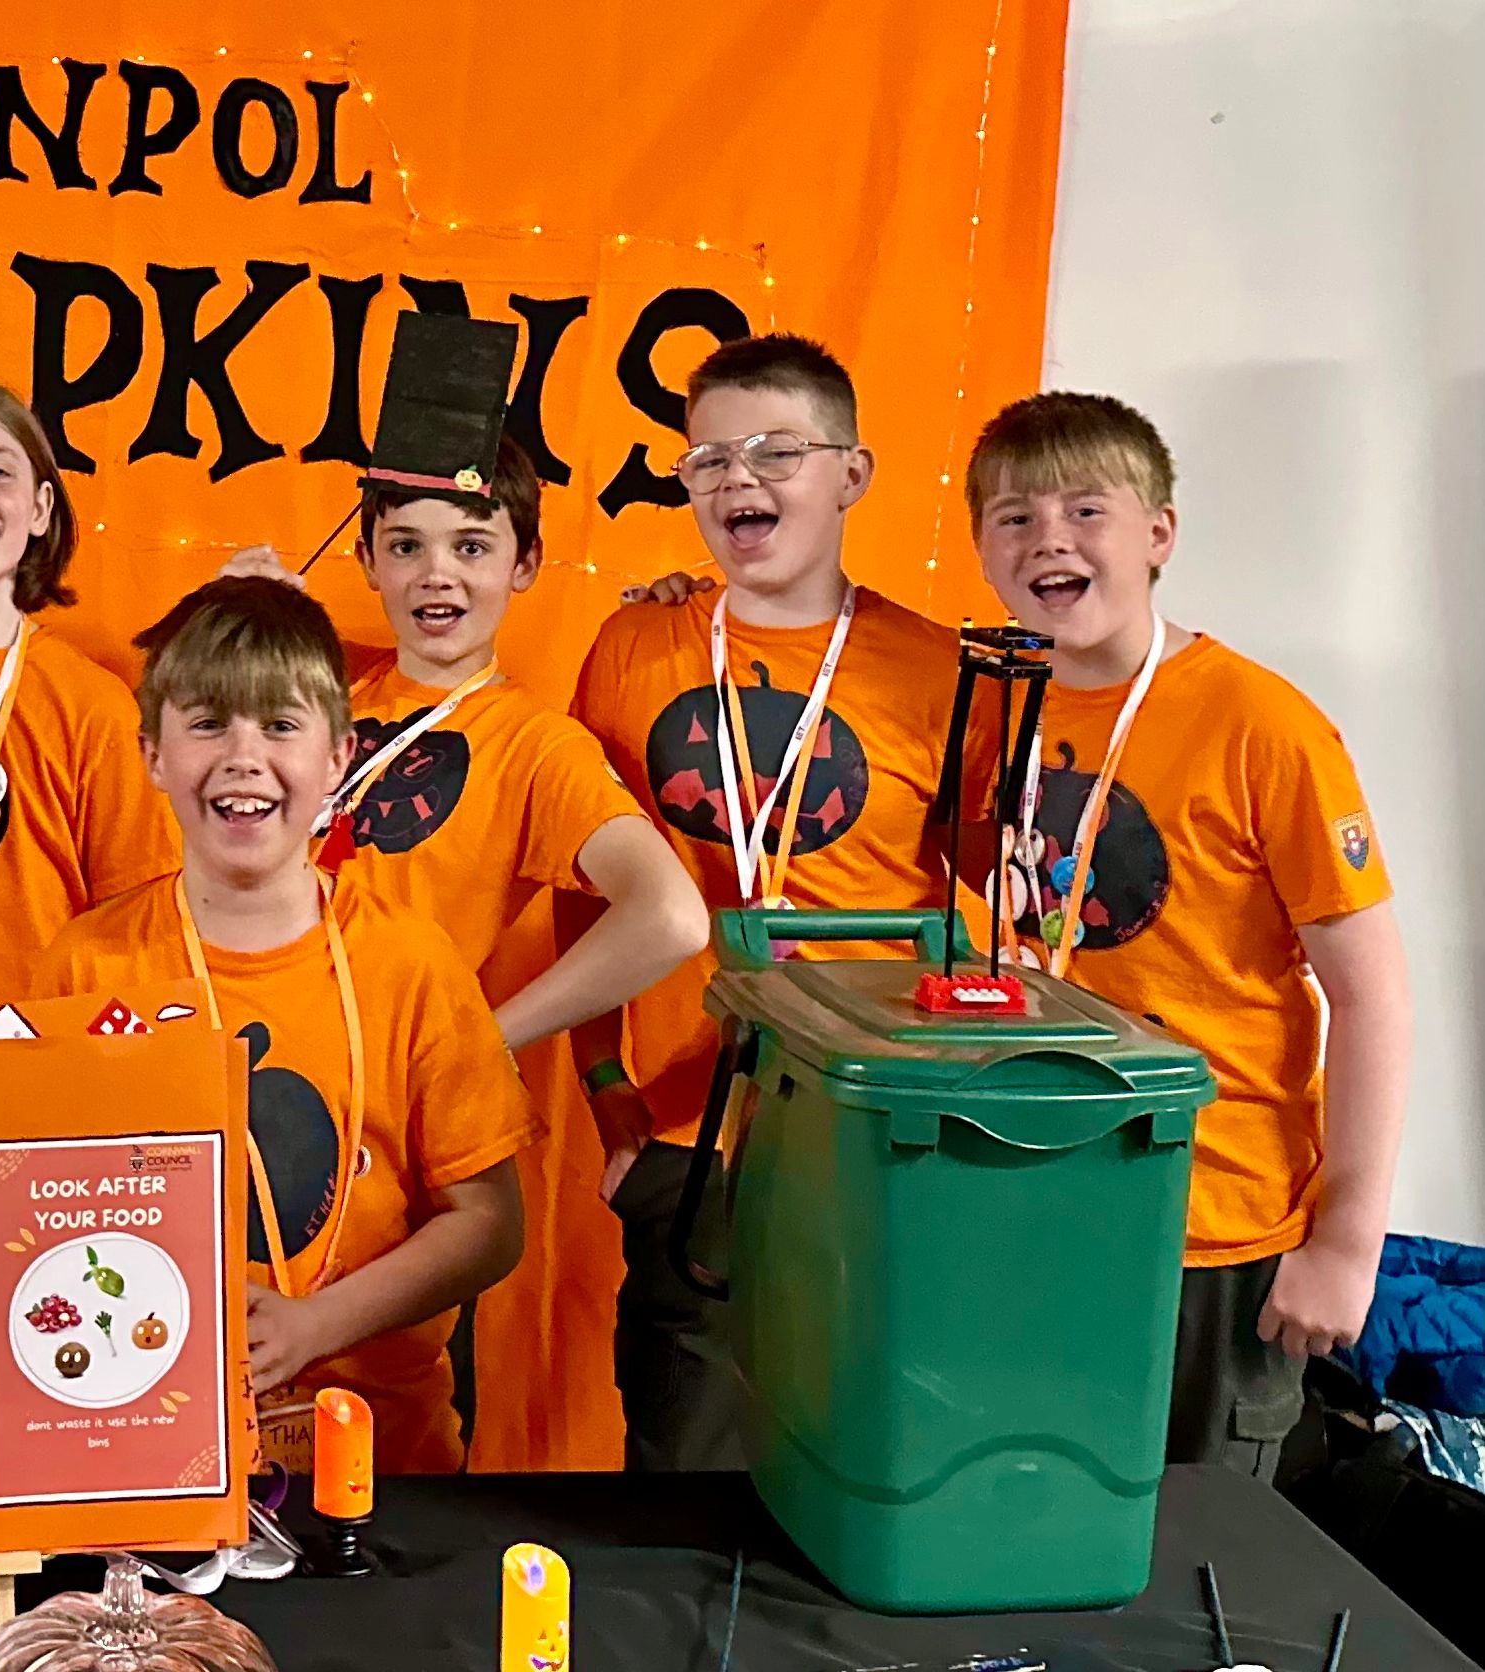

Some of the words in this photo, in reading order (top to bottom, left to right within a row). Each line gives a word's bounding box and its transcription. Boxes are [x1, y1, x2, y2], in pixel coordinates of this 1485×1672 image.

[29, 1178, 91, 1200] LOOK
[96, 1175, 167, 1197] AFTER
[34, 1209, 97, 1231] YOUR
[102, 1207, 163, 1228] FOOD
[26, 1420, 52, 1431] dont
[56, 1418, 91, 1429] waste
[94, 1416, 104, 1428] it
[107, 1416, 127, 1427] use
[131, 1414, 149, 1426] the
[152, 1415, 176, 1425] new
[87, 1436, 110, 1448] bins
